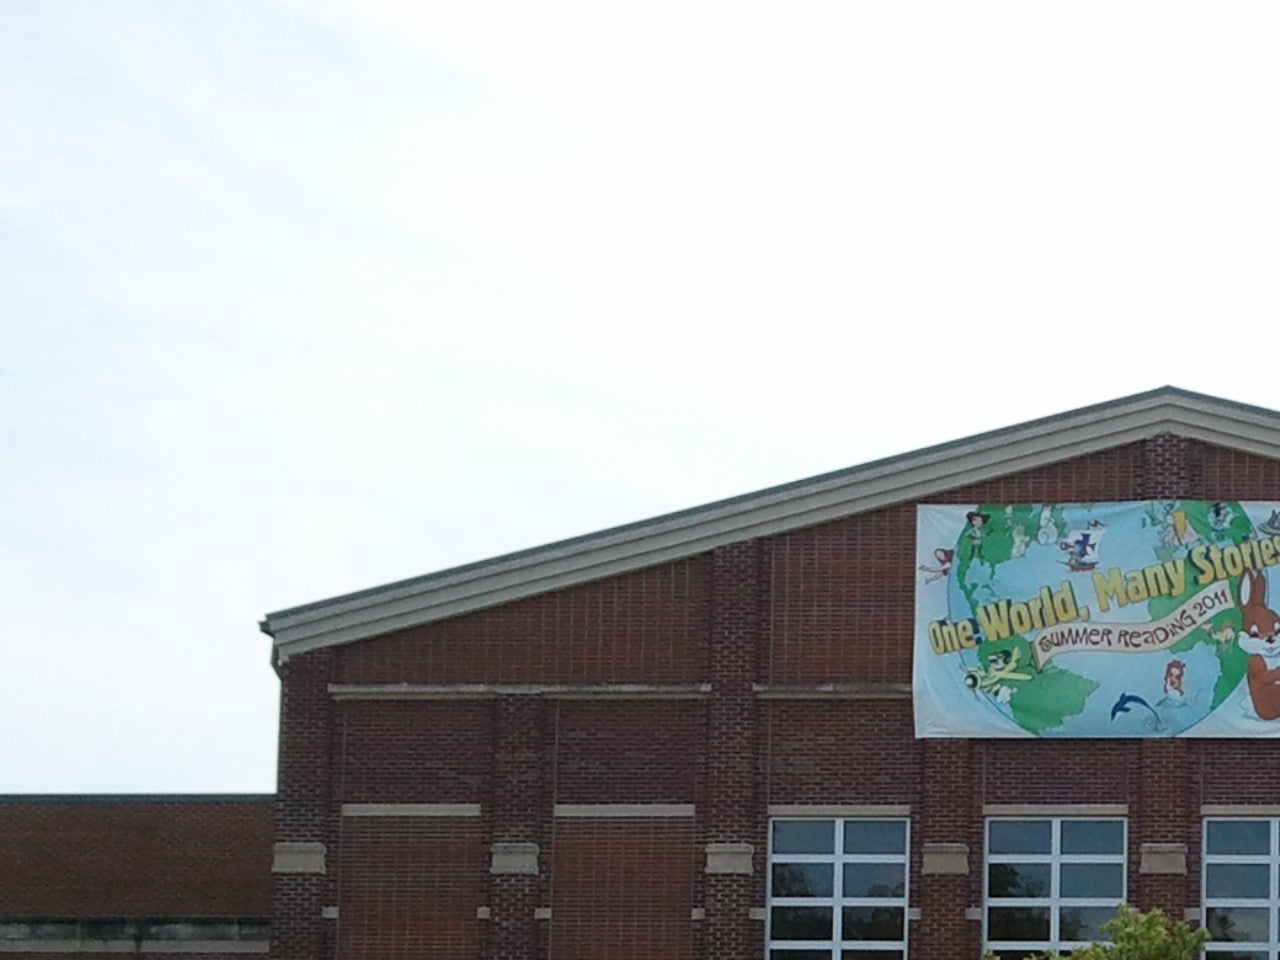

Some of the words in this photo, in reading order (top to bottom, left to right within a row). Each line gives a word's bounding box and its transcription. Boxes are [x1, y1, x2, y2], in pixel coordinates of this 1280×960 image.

[928, 618, 977, 656] One
[977, 580, 1090, 642] World,
[1092, 559, 1185, 613] Many
[1192, 589, 1229, 617] 2011
